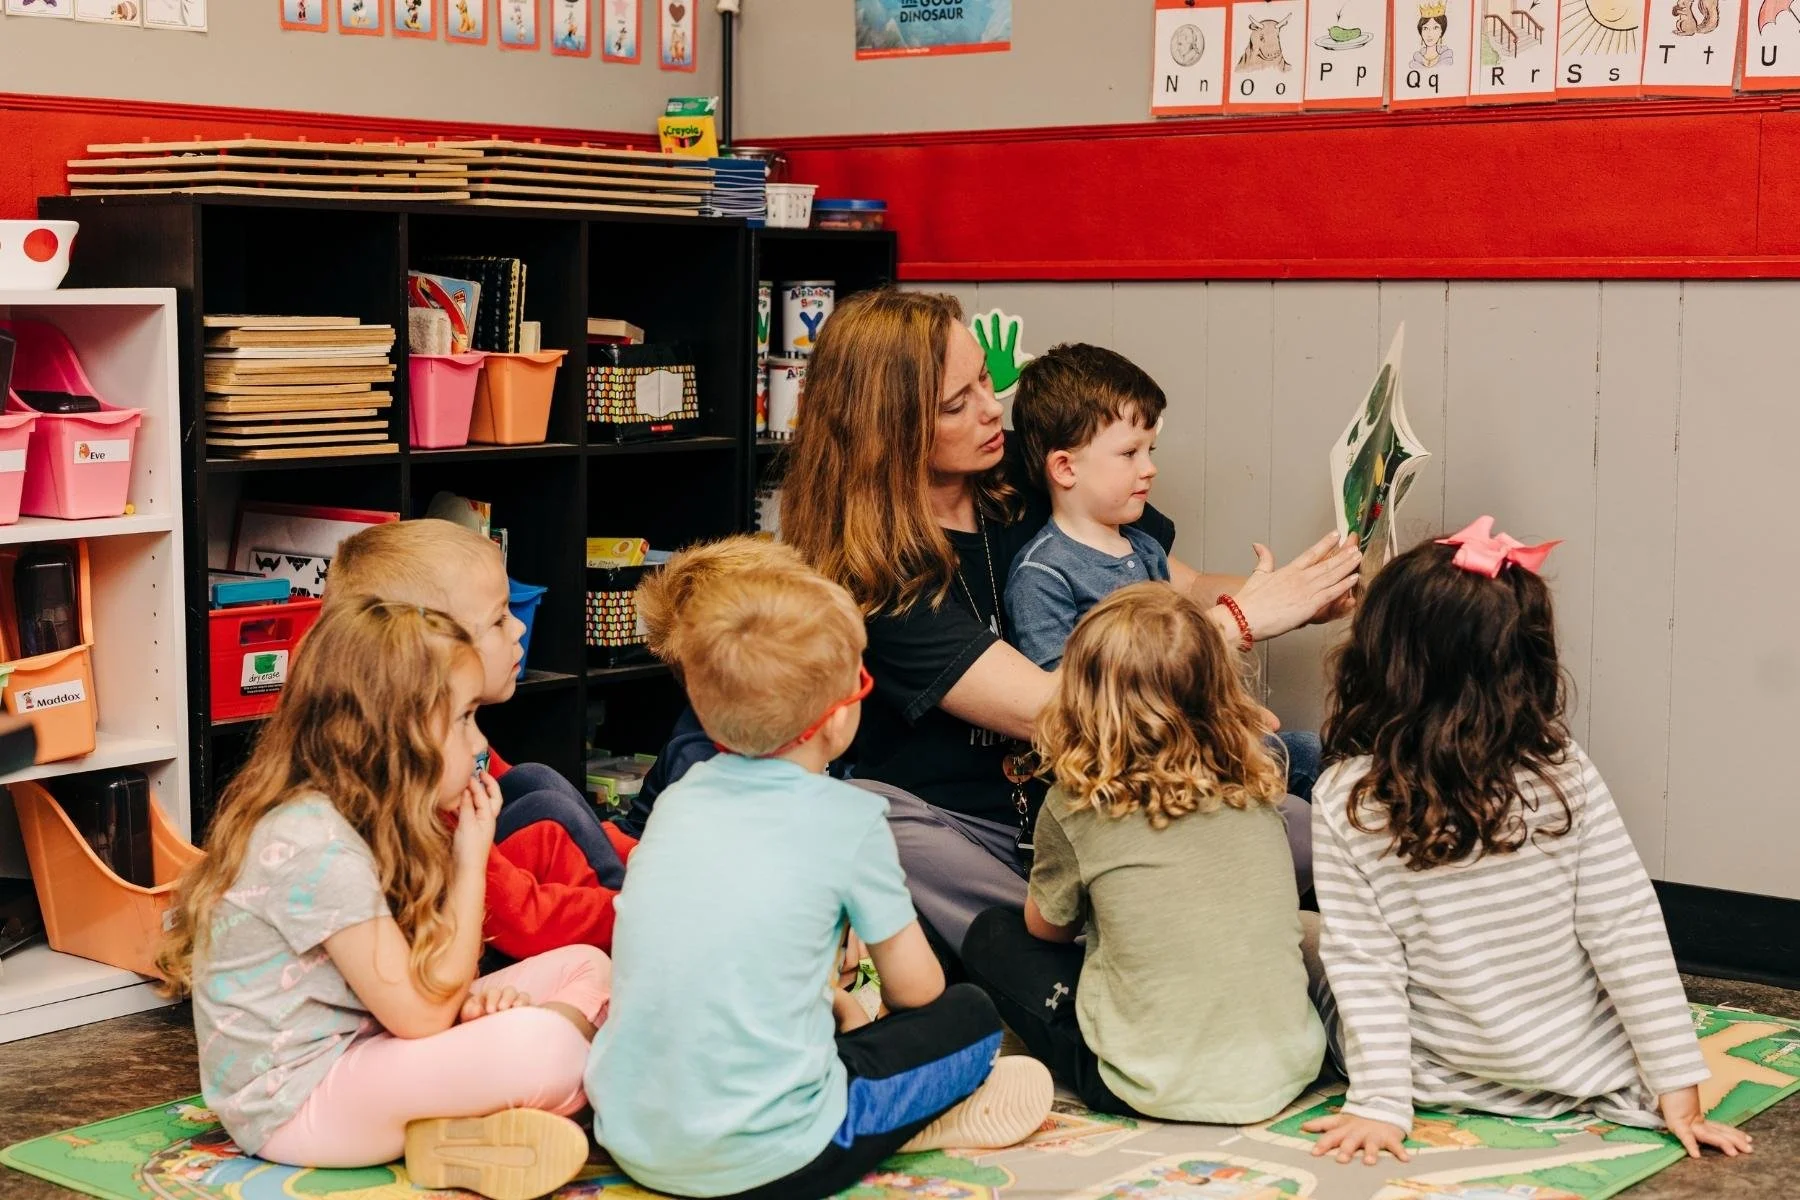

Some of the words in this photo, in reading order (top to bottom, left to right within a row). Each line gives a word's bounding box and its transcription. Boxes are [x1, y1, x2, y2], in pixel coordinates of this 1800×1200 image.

[900, 7, 963, 23] DINOSAUR
[1659, 45, 1675, 64] T
[1703, 45, 1714, 64] t
[1761, 46, 1777, 66] U
[1320, 62, 1332, 81] P
[1356, 66, 1367, 86] p
[1491, 66, 1504, 86] R
[1531, 68, 1540, 83] r
[1567, 64, 1582, 83] S
[1609, 68, 1620, 81] s
[1166, 75, 1178, 92] N
[1199, 79, 1208, 92] n
[1240, 78, 1254, 96] O
[1275, 83, 1286, 95] o
[666, 125, 700, 137] Crayola
[800, 312, 823, 342] Y
[90, 451, 106, 460] Eve
[249, 673, 260, 684] dry
[262, 671, 280, 681] erase
[37, 692, 81, 708] Maddox
